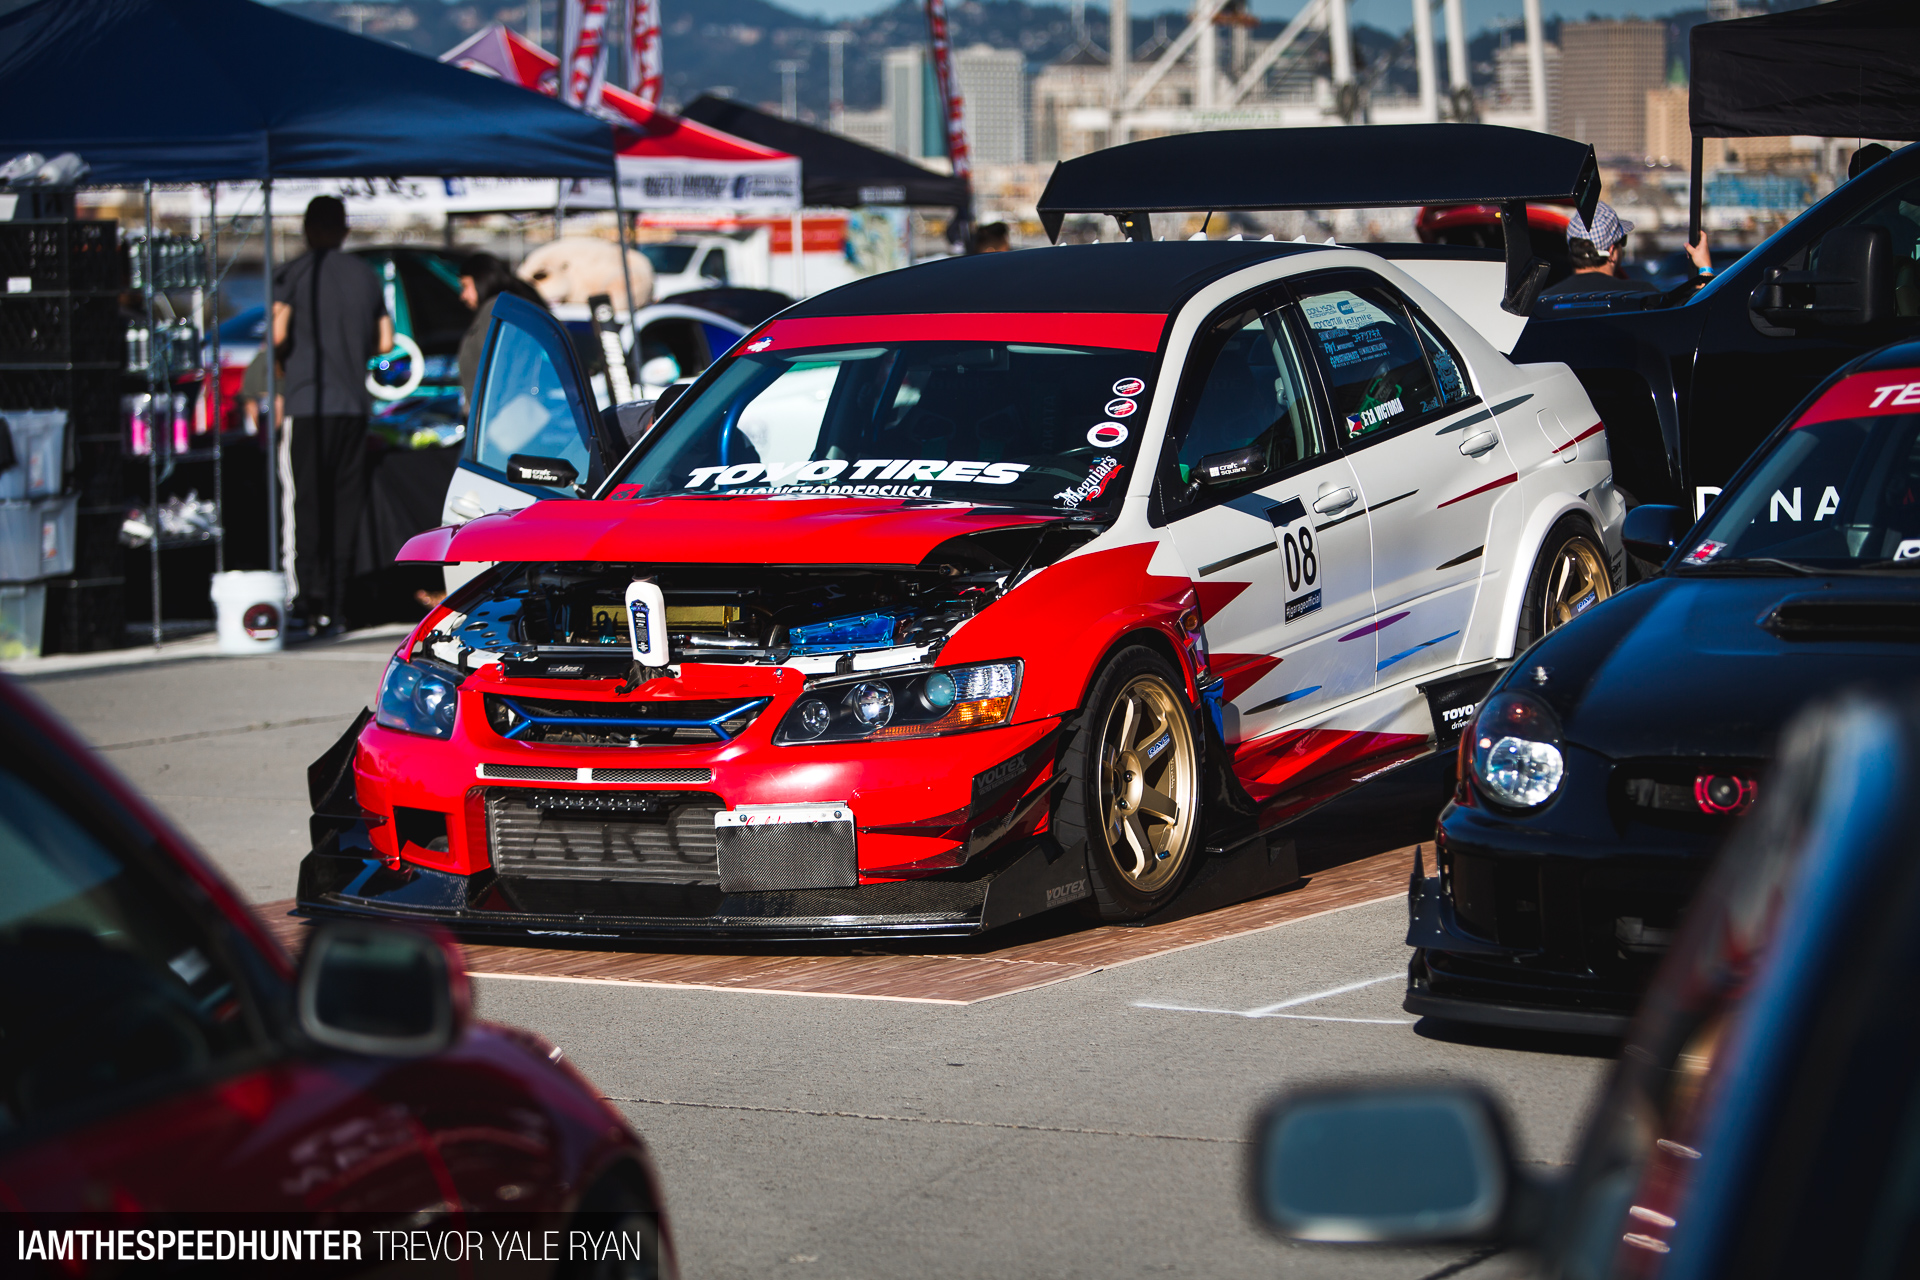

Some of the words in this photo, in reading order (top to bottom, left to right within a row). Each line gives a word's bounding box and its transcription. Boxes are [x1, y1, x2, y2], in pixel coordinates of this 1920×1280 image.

[1374, 397, 1405, 421] VICTORIA
[684, 460, 850, 490] TOYO
[850, 459, 1031, 485] TIRES
[1219, 462, 1238, 471] craft
[1220, 466, 1247, 476] square
[1284, 526, 1317, 592] 08
[1442, 704, 1475, 722] TOYO
[1147, 733, 1171, 757] RAYS
[976, 753, 1026, 789] VOLTEX
[1046, 879, 1087, 901] VOLTEX
